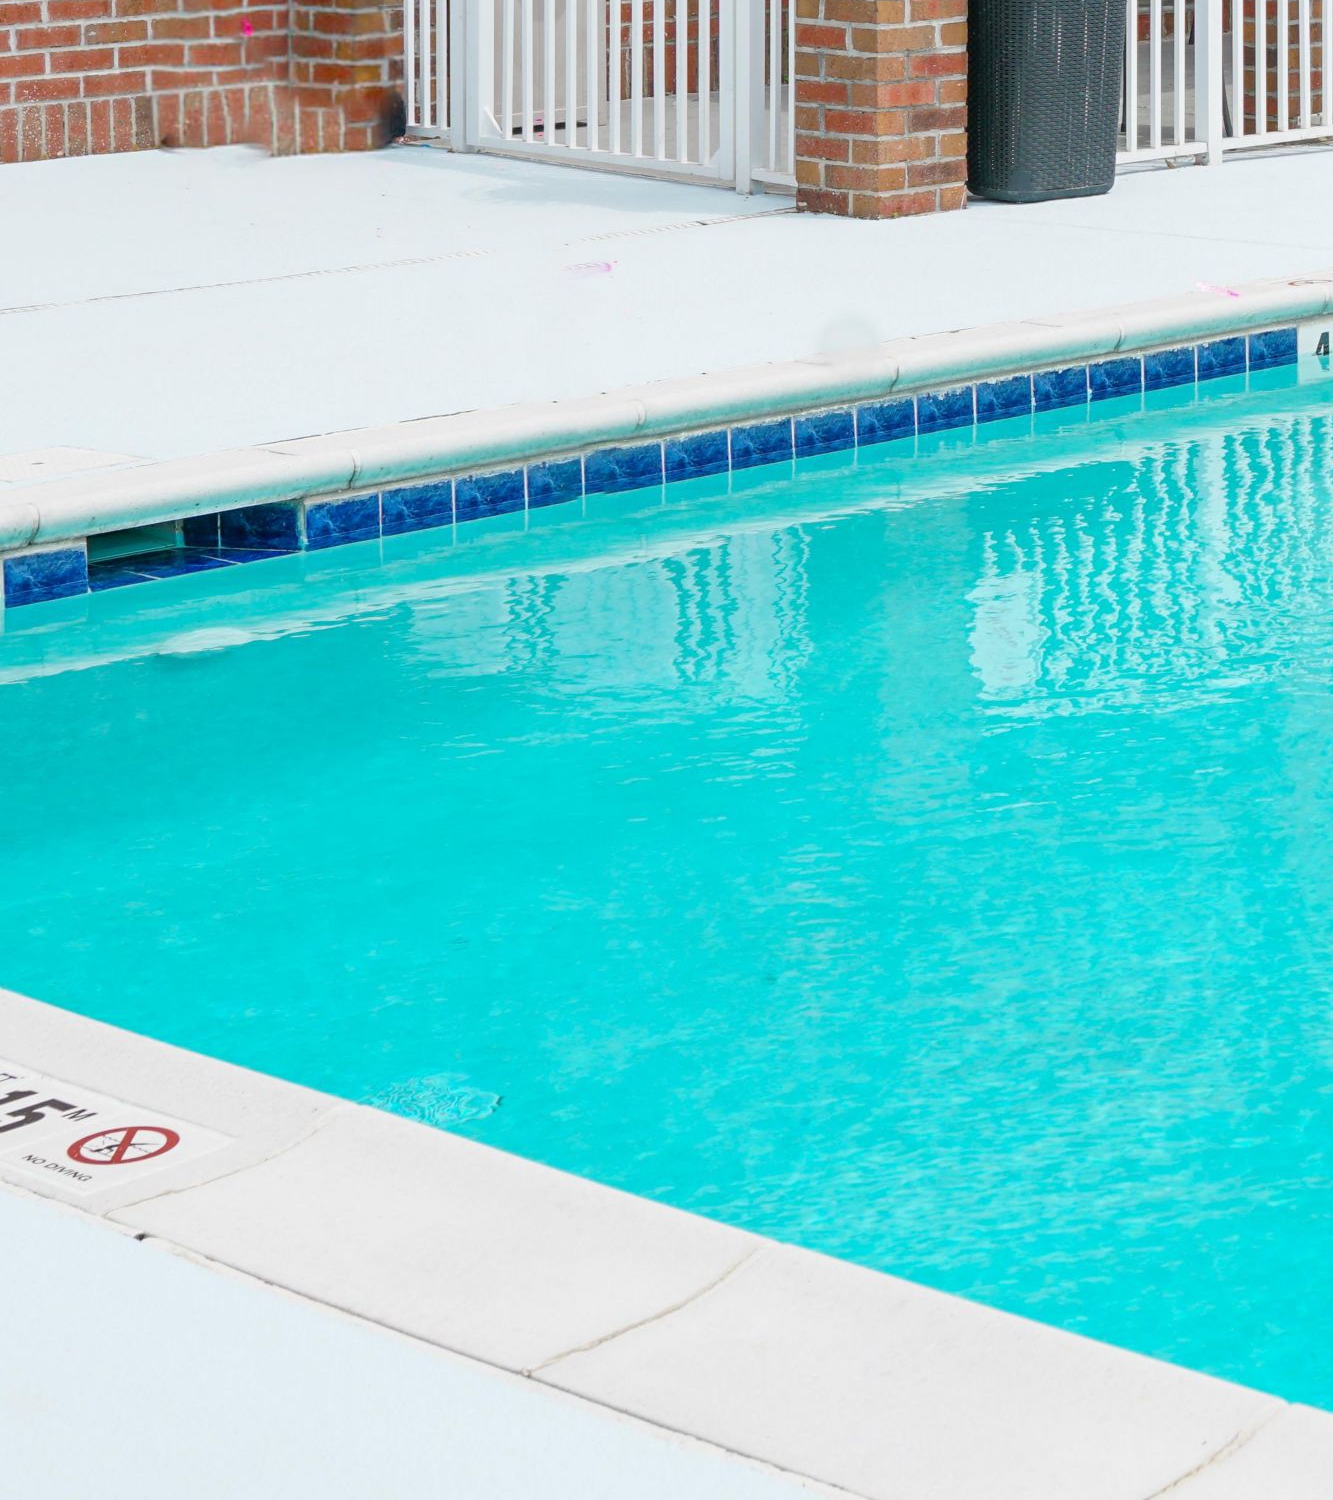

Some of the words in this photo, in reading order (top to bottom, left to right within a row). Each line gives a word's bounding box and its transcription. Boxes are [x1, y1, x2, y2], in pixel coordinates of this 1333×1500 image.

[1315, 331, 1330, 356] 4
[22, 1154, 46, 1165] NO
[44, 1162, 93, 1182] DIVING
